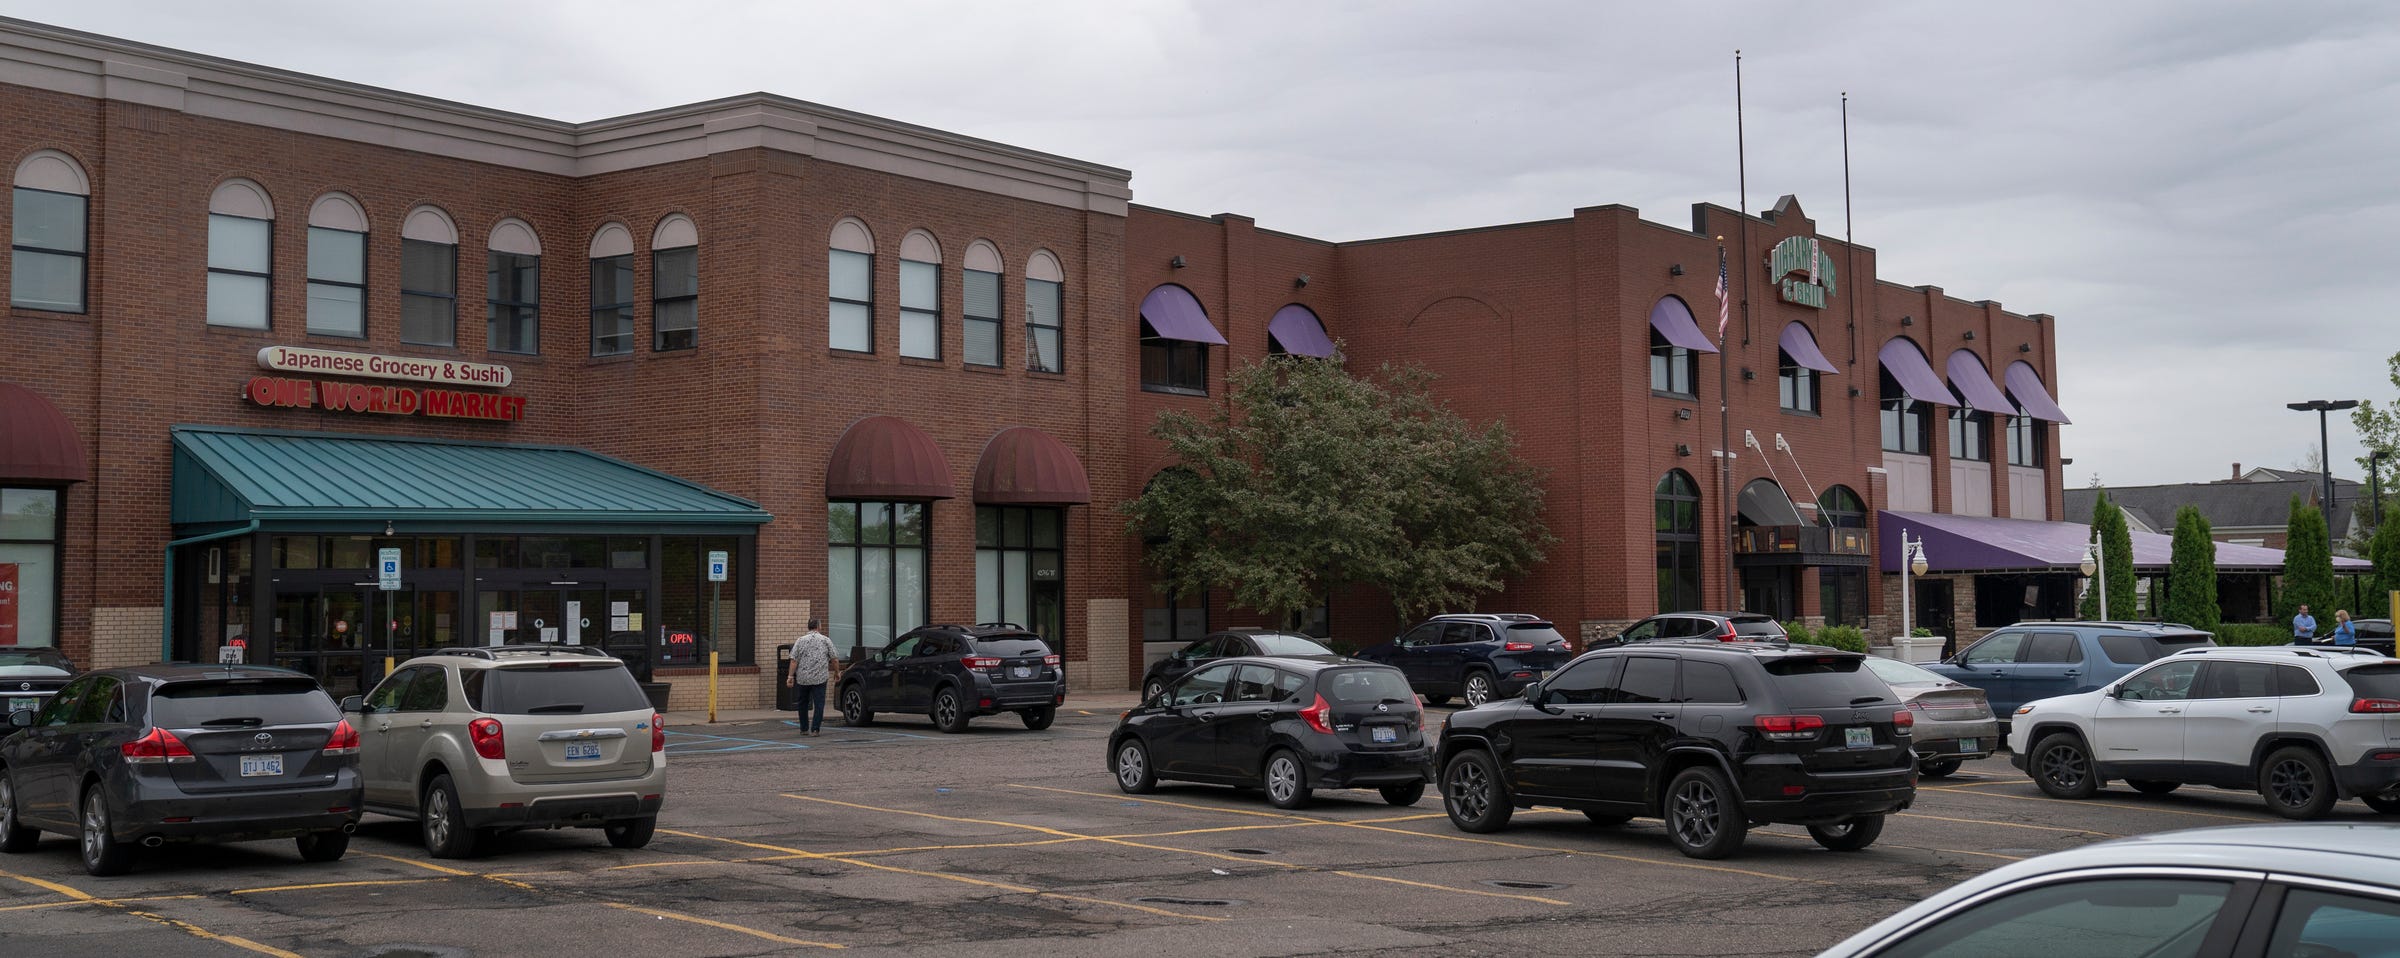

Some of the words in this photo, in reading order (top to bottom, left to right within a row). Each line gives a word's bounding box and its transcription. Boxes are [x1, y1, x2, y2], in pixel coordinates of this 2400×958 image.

[1794, 281, 1828, 309] GRILL
[277, 349, 364, 371] Japanese
[369, 356, 437, 380] Grocery
[443, 363, 456, 379] &
[460, 364, 505, 383] Sushi
[248, 376, 313, 407] ONE
[319, 381, 417, 414] WORLD
[423, 388, 527, 421] MARKET
[670, 633, 693, 644] OPEN
[262, 760, 280, 771] 1462
